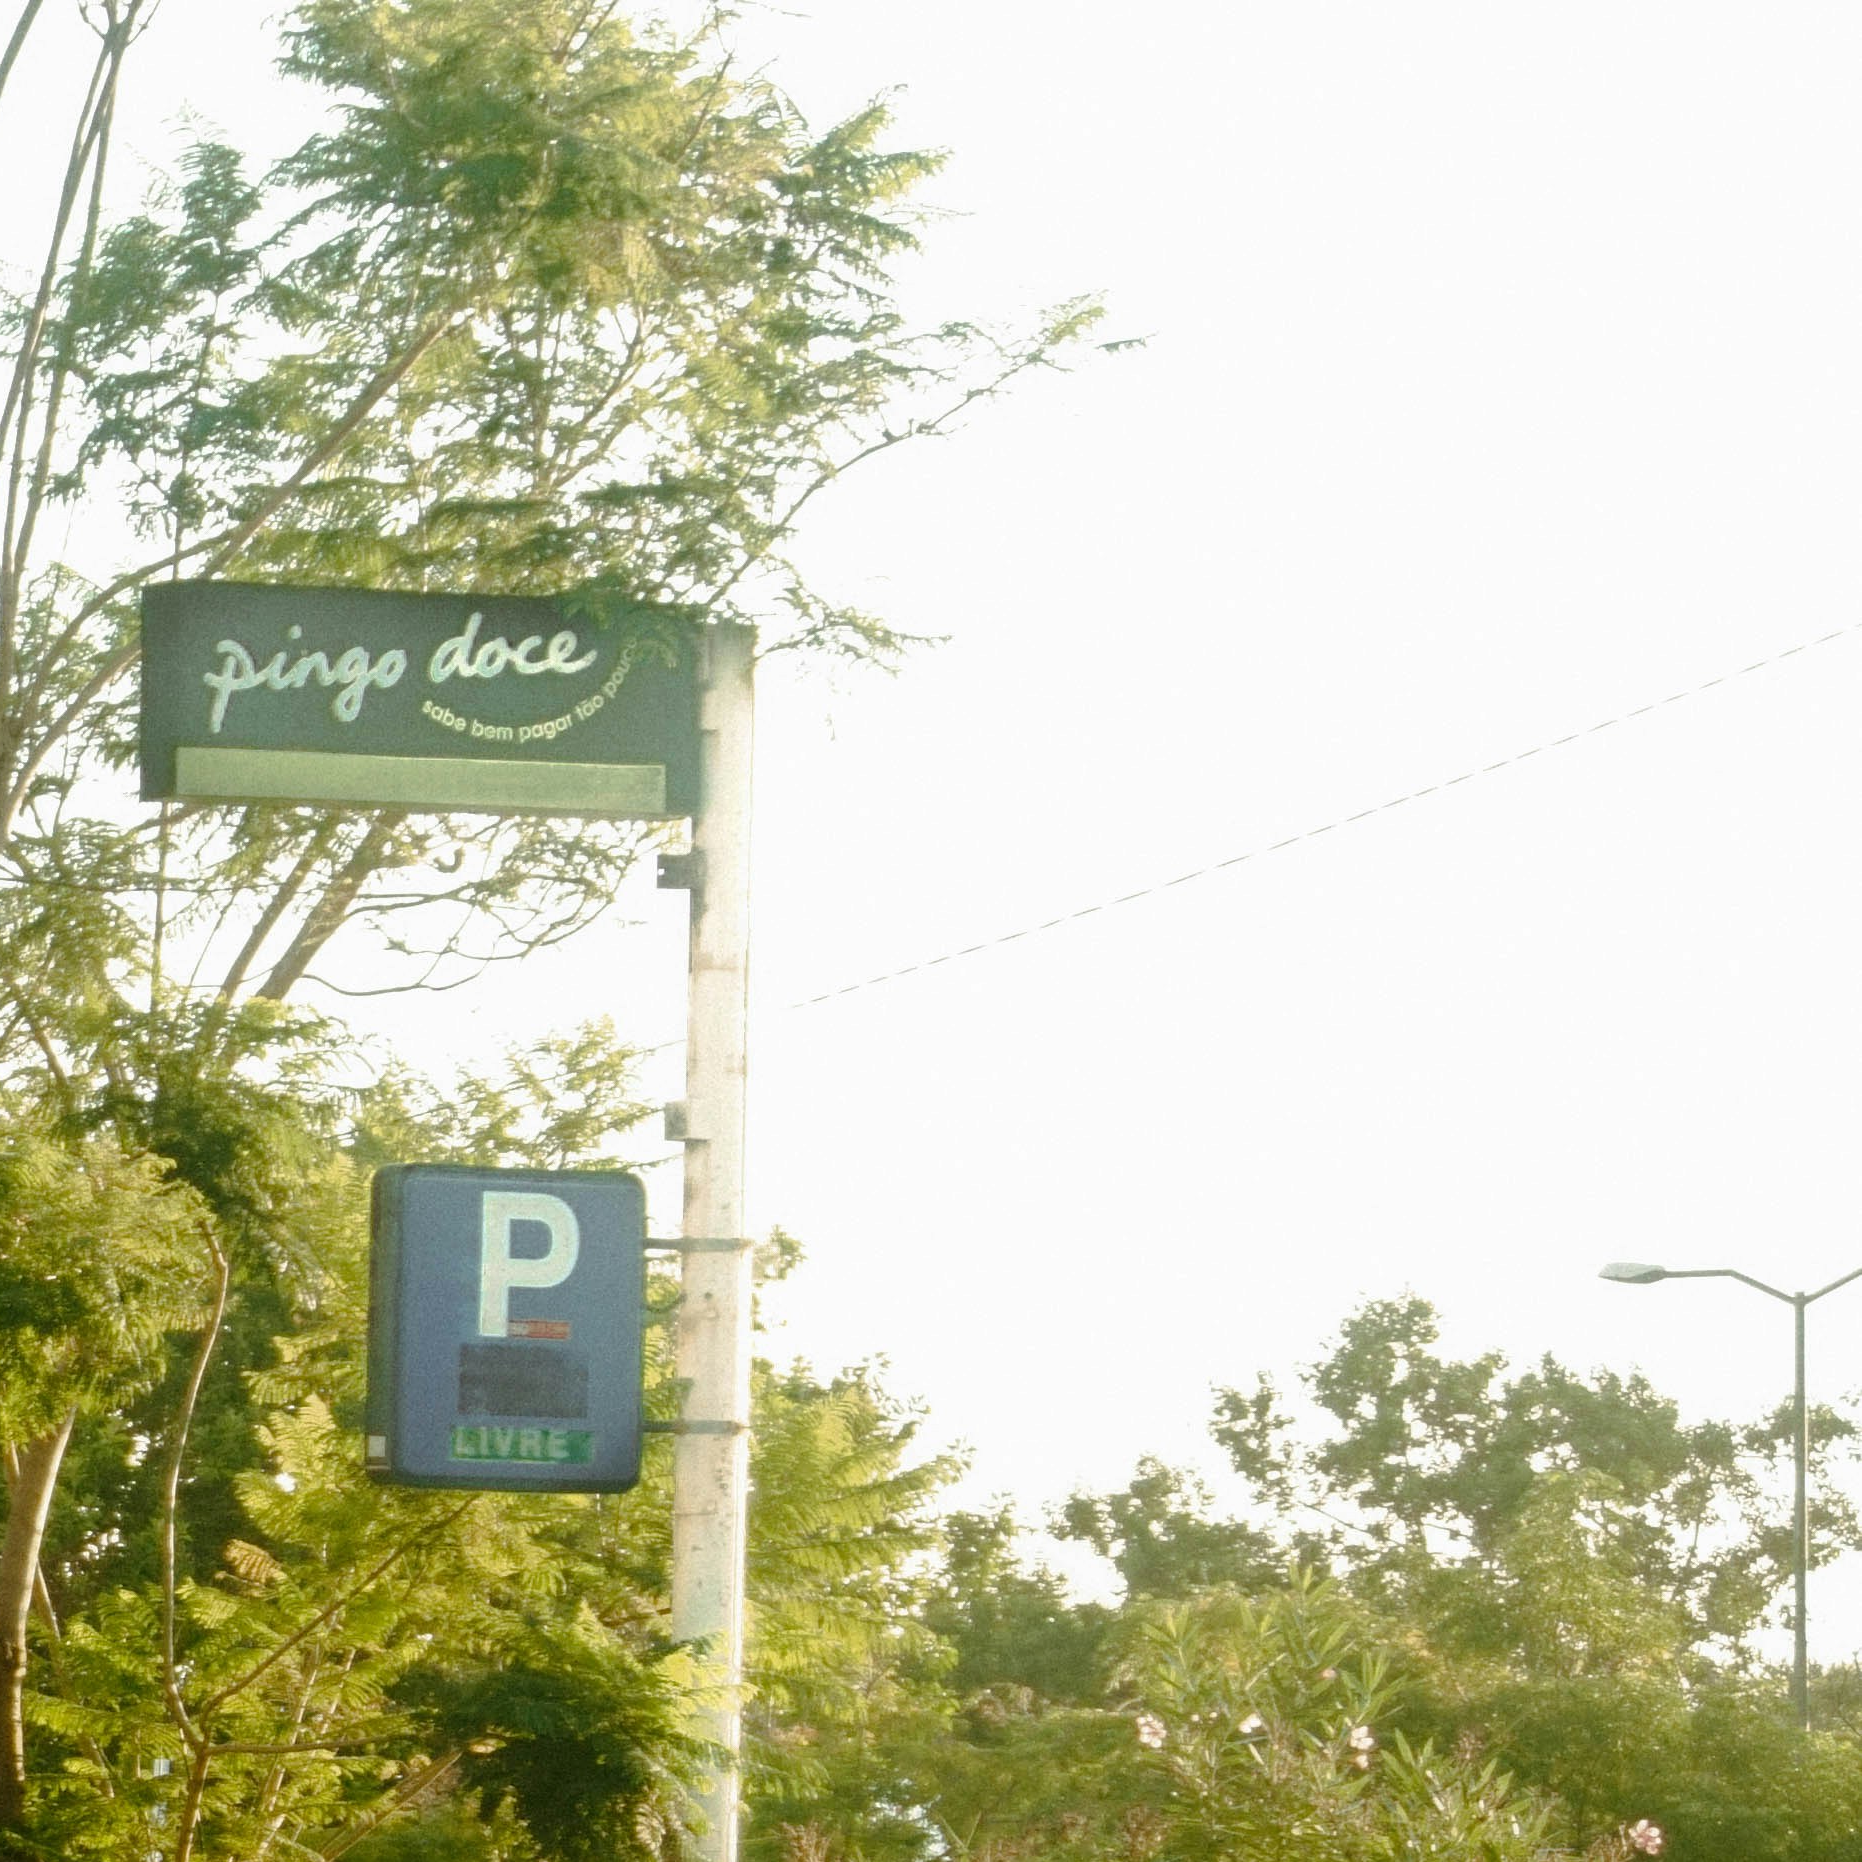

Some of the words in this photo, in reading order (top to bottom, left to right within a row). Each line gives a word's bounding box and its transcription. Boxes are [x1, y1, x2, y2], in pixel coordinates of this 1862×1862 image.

[203, 624, 407, 733] pingo
[429, 612, 597, 683] doce
[422, 700, 466, 731] sabe
[471, 720, 513, 741] bem
[519, 714, 573, 743] pagar
[575, 695, 604, 721] tão
[479, 1190, 579, 1337] P
[456, 1426, 570, 1458] LIVRE
